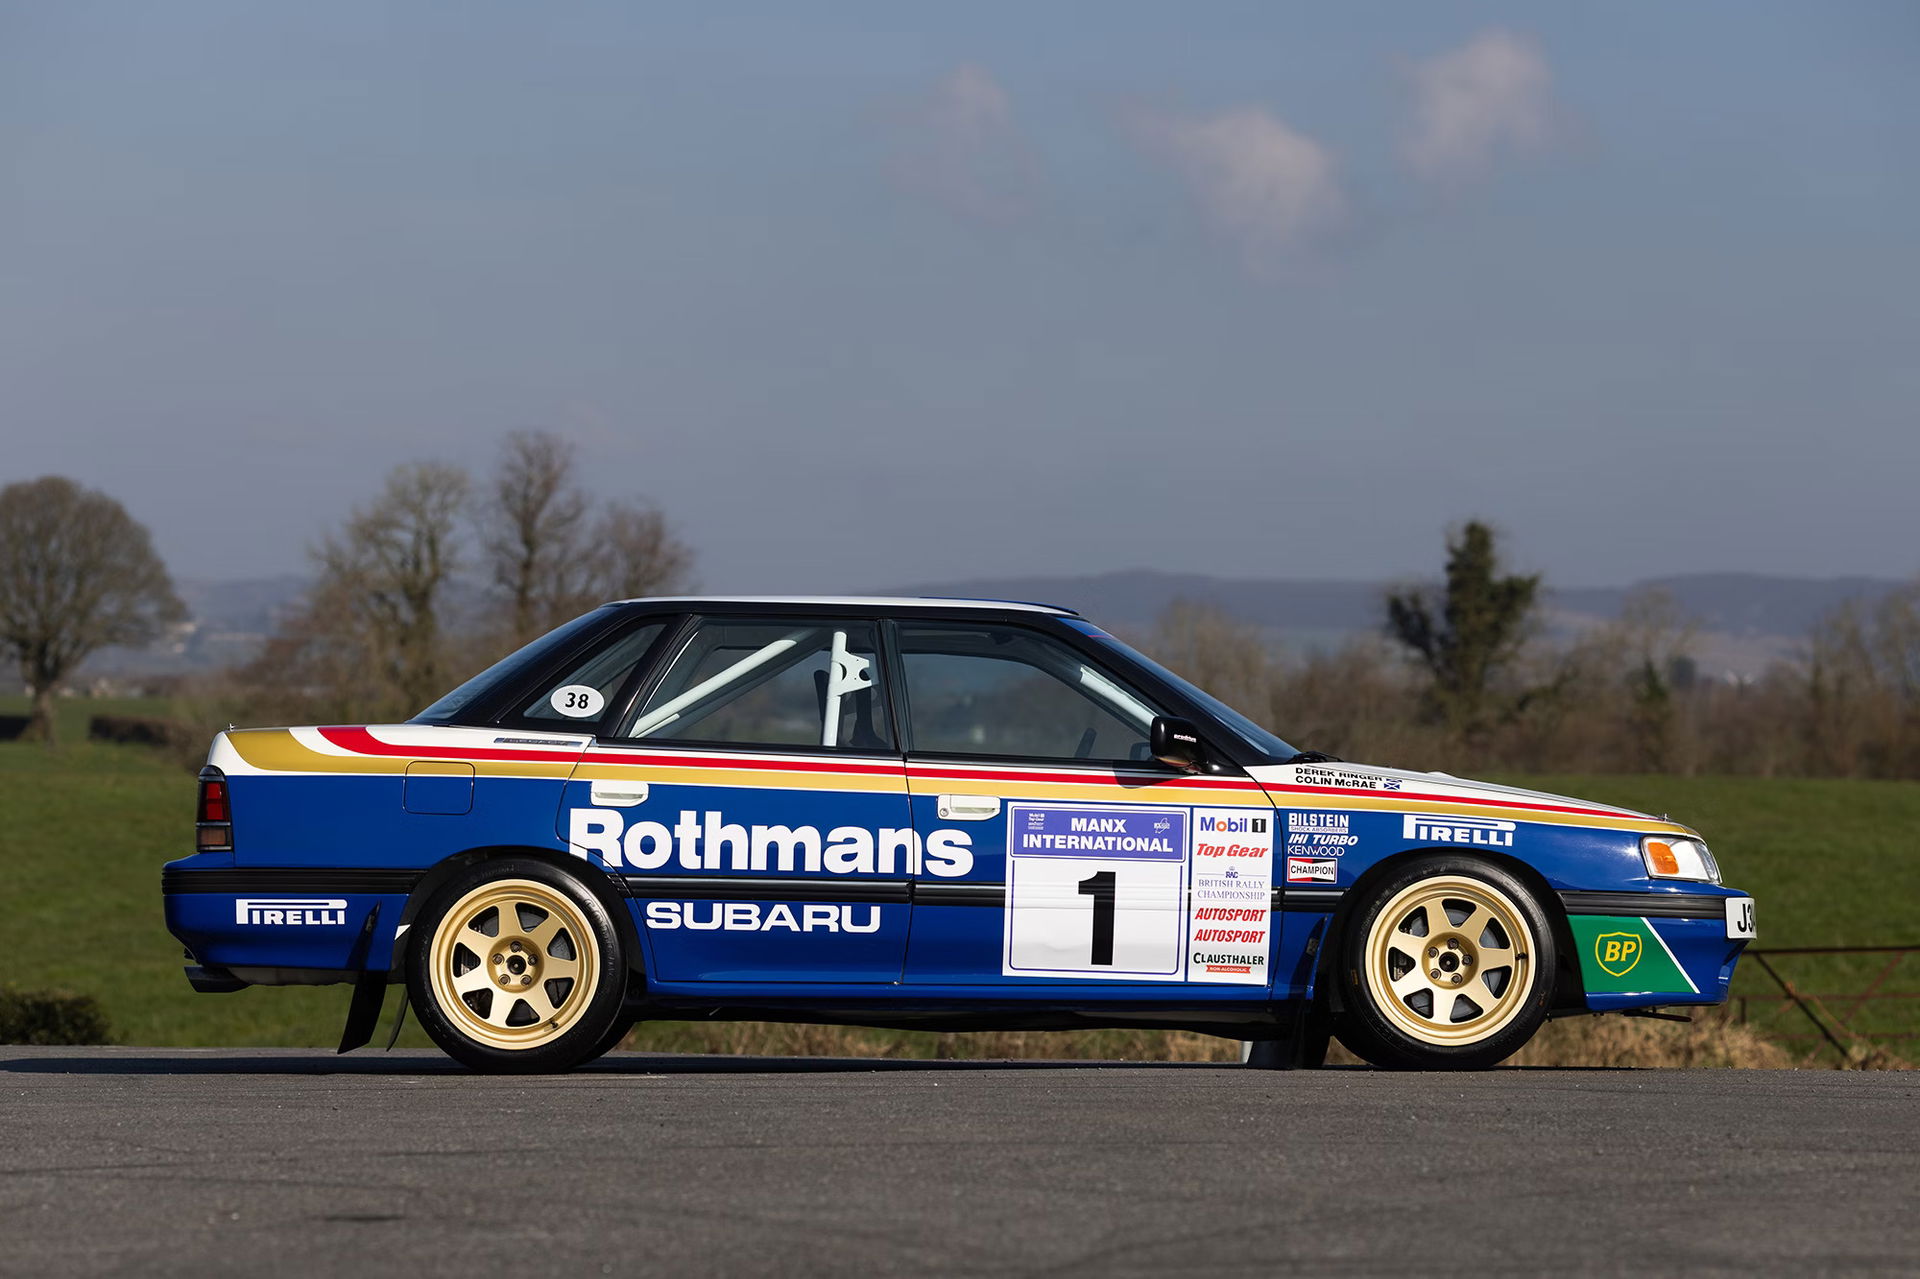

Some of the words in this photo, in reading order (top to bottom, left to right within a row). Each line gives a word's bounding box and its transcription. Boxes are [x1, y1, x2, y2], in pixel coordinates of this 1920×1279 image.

[565, 692, 589, 709] 38
[1295, 767, 1335, 777] DEREK
[1295, 775, 1332, 786] COLIN
[1334, 778, 1377, 789] McRAE
[1071, 817, 1127, 833] MANX
[1200, 817, 1247, 832] Mobil
[1288, 813, 1349, 827] BILSTEIN
[1403, 814, 1516, 846] PIRELLI
[568, 808, 975, 877] Rothmans
[1022, 834, 1173, 852] INTERNATIONAL
[1288, 833, 1309, 844] IHI
[1312, 834, 1359, 846] TURBO
[1197, 843, 1225, 858] Top
[1227, 844, 1268, 858] Gear
[1287, 845, 1345, 856] KENWOOD
[1290, 865, 1334, 875] CHAMPION
[1198, 879, 1233, 888] BRITISH
[1235, 880, 1265, 889] RALLY
[1197, 890, 1265, 900] CHAMPIONSHIP
[235, 899, 348, 925] PIRELLI
[646, 902, 881, 934] SUBARU
[1078, 871, 1116, 965] 1
[1194, 908, 1267, 921] AUTOSPORT
[1193, 929, 1266, 943] AUTOSPORT
[1193, 952, 1264, 965] CLAUSTHALER
[1603, 941, 1637, 962] BP
